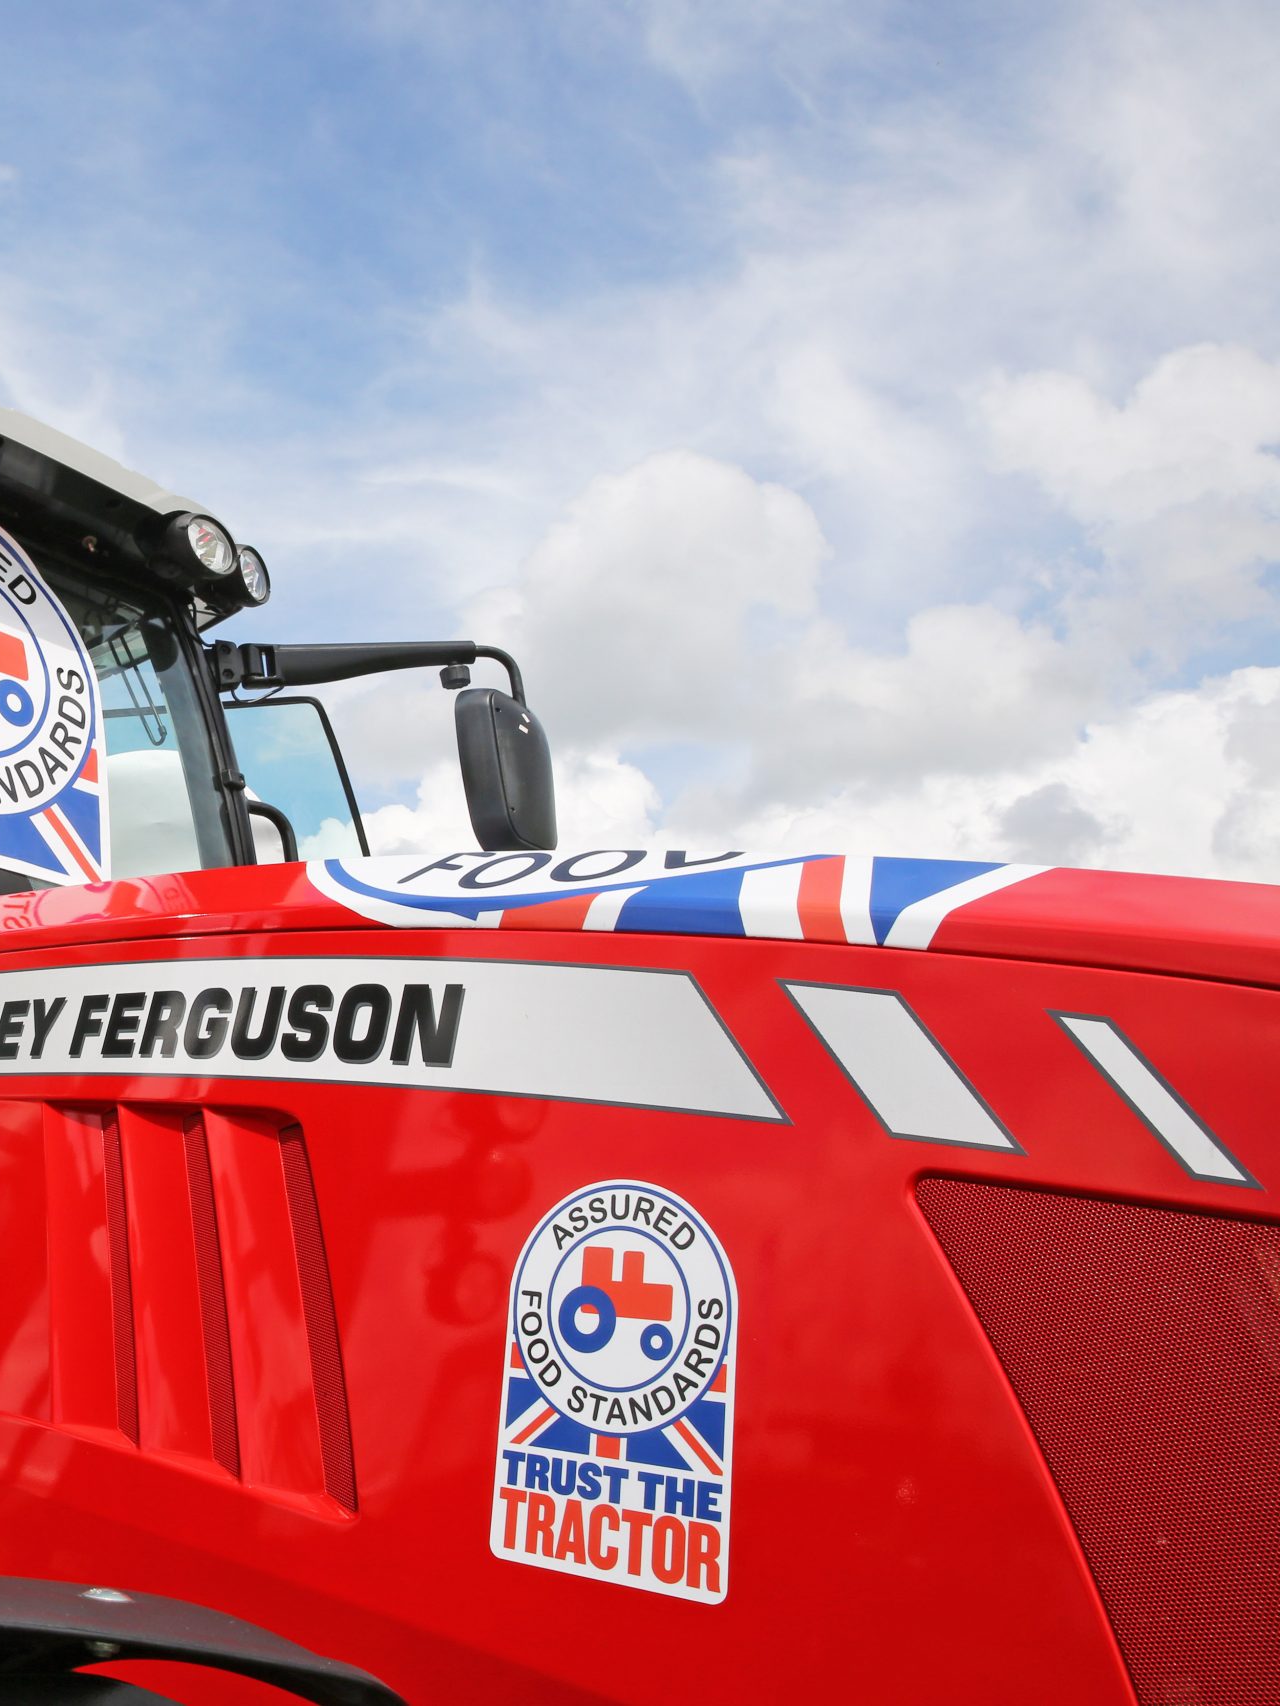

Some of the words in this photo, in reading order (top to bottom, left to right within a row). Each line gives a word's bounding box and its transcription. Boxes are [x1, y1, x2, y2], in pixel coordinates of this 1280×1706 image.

[69, 983, 465, 1068] FERGUSON
[551, 1193, 696, 1251] ASSURED
[520, 1289, 562, 1388] FOOD
[567, 1298, 724, 1427] STANDARDS
[502, 1449, 629, 1505] TRUST
[637, 1471, 723, 1522] THE
[499, 1486, 721, 1593] TRACTOR
